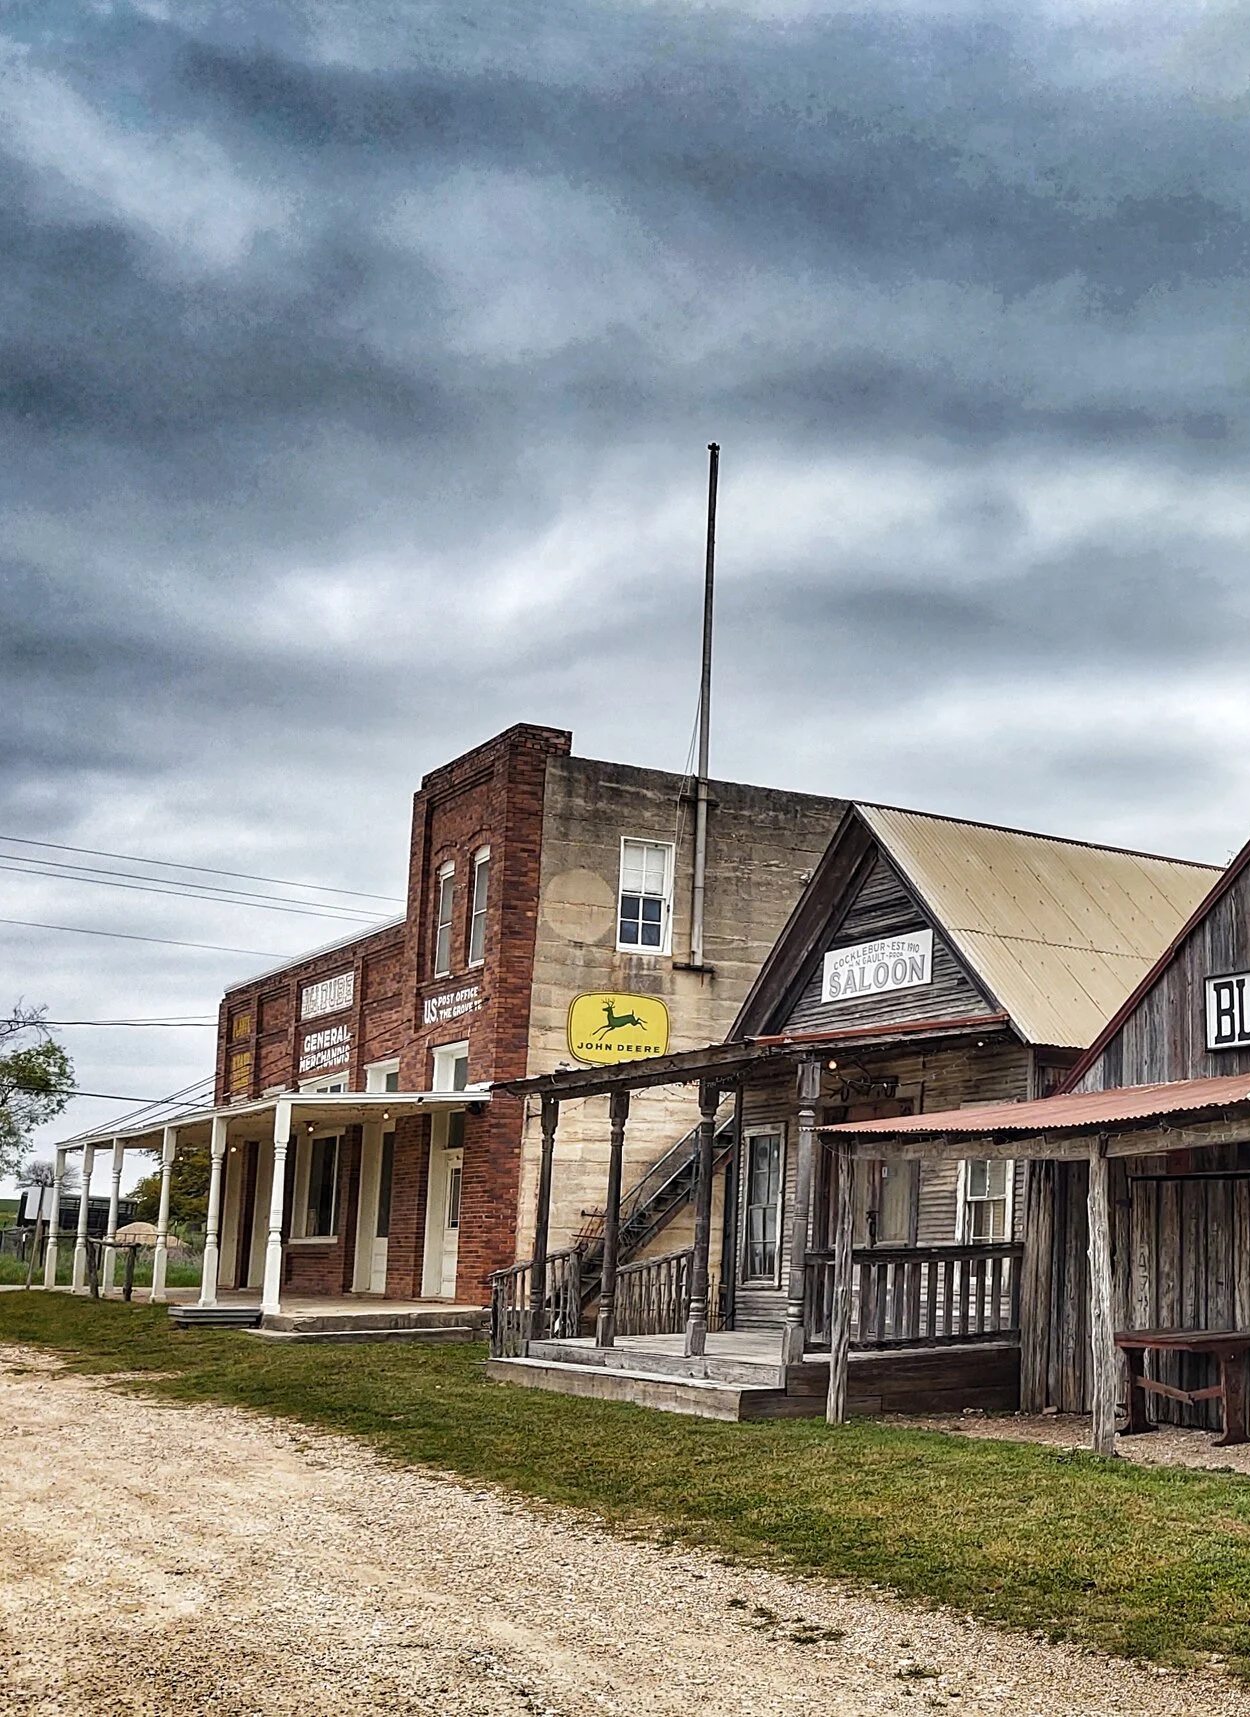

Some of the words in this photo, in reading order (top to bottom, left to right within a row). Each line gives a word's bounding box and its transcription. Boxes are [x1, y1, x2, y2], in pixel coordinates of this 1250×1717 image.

[829, 954, 926, 998] SALOON
[438, 993, 455, 1007] POST
[456, 986, 478, 1002] OFFICE
[439, 1007, 453, 1020] THE
[304, 1025, 351, 1053] GENERAL
[577, 1042, 612, 1051] JOHN
[617, 1044, 660, 1053] DEERE
